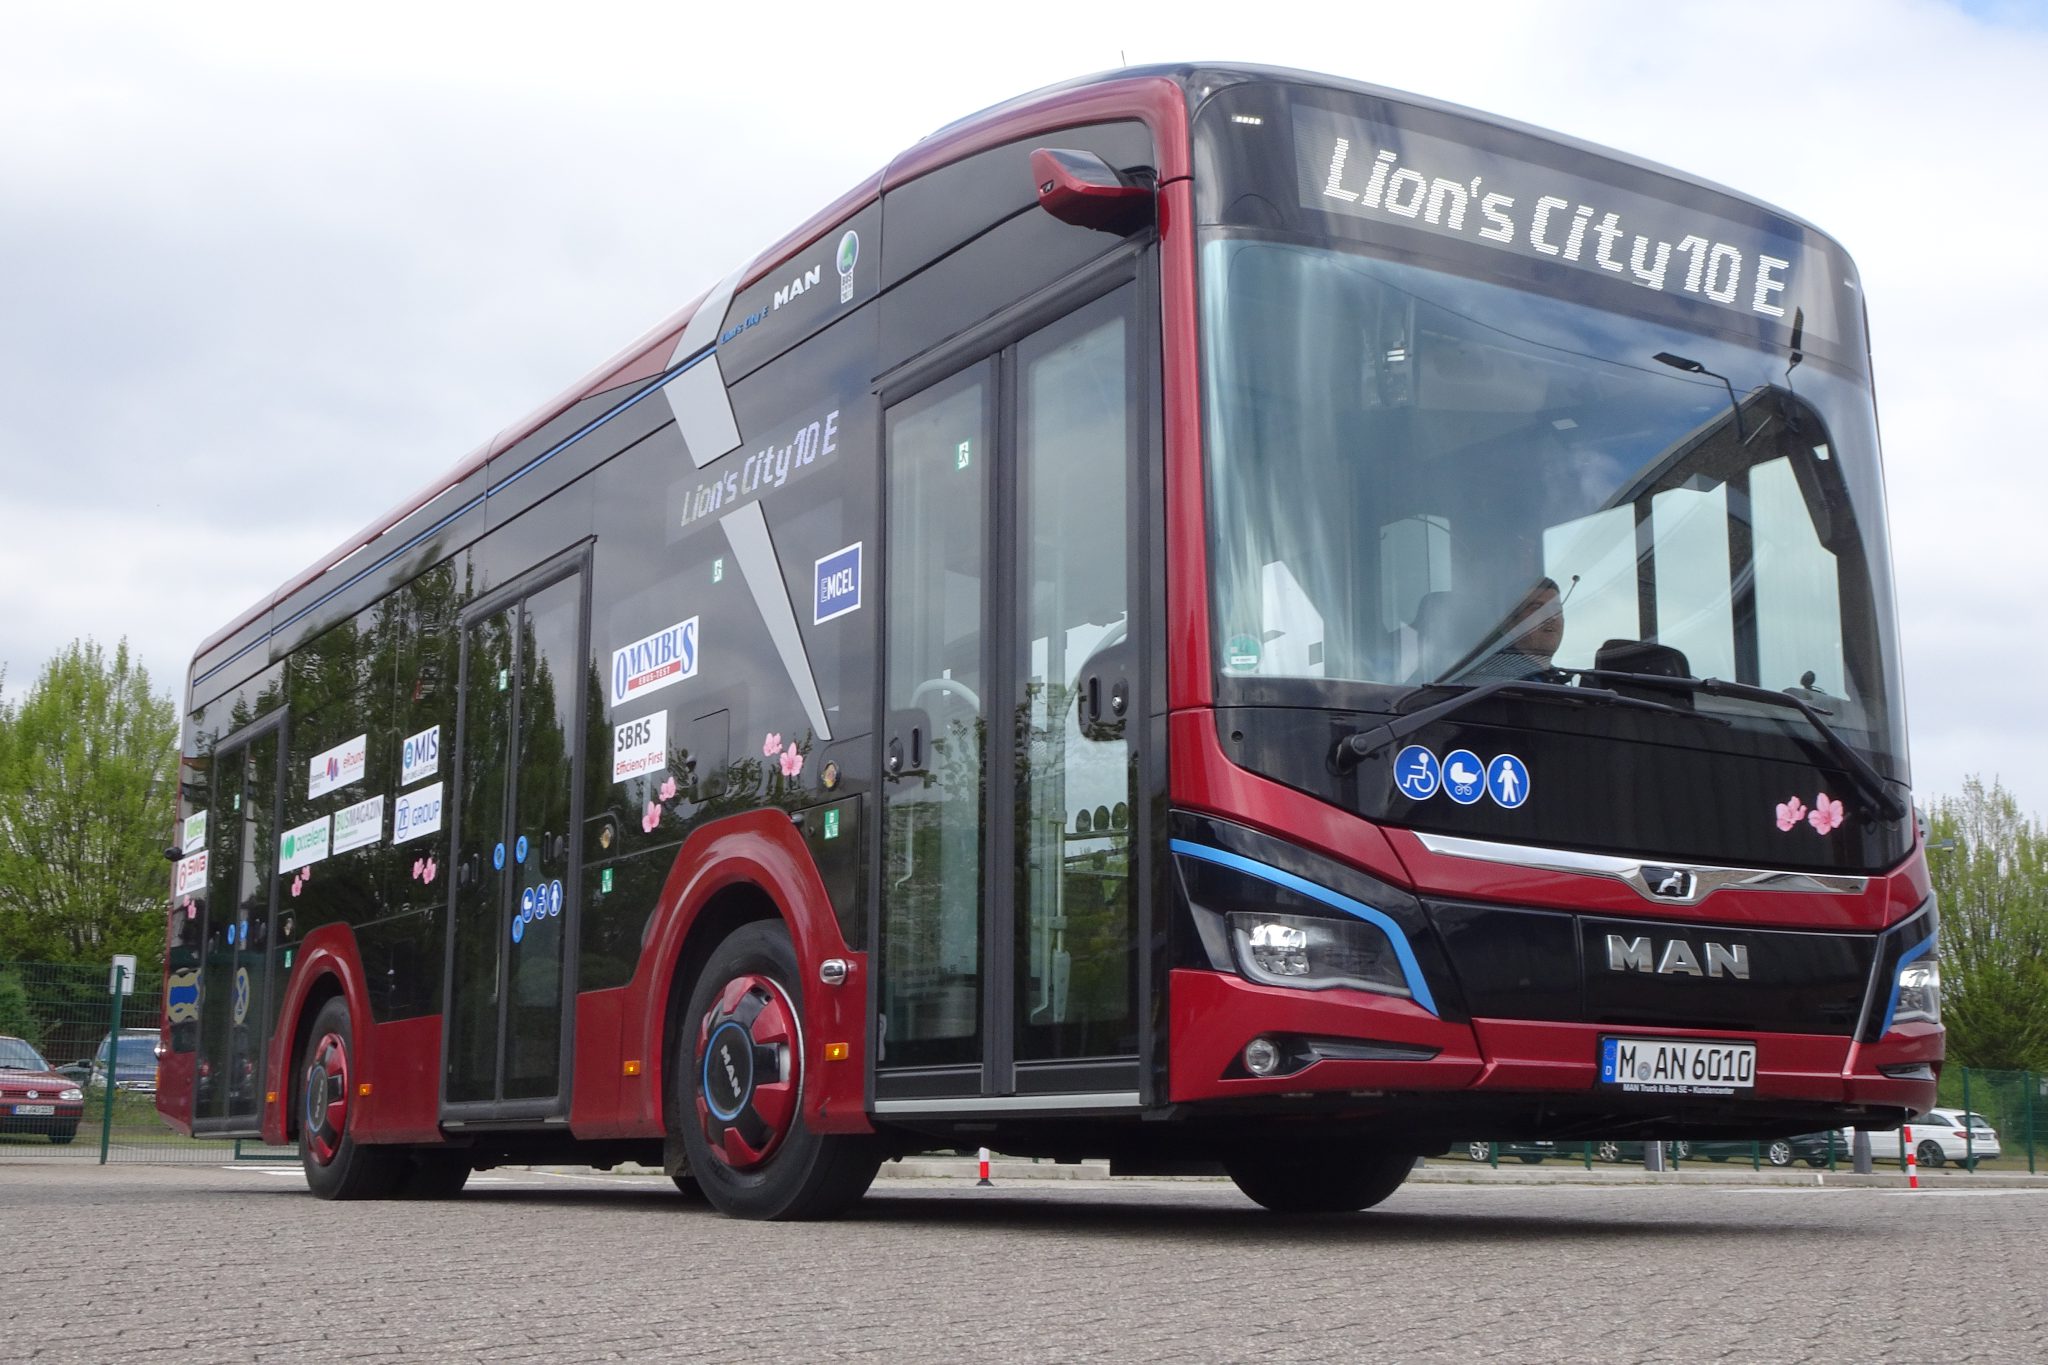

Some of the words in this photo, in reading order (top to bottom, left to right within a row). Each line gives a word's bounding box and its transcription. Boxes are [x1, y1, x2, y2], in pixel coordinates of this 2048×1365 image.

[1323, 137, 1515, 243] Lion's
[1753, 254, 1789, 317] E
[773, 264, 821, 311] MAN
[681, 470, 738, 526] Lion's
[822, 409, 839, 456] E
[615, 622, 694, 700] OMNIBUS
[617, 719, 651, 752] SBRS
[647, 751, 664, 766] First
[412, 800, 440, 826] GROUP
[1605, 934, 1750, 980] MAN
[720, 1044, 742, 1098] MAN
[1605, 1065, 1612, 1076] D
[1619, 1045, 1637, 1078] M
[1623, 1083, 1639, 1092] MAN
[1641, 1084, 1657, 1092] Truck
[1665, 1085, 1677, 1093] Bus
[1678, 1086, 1687, 1094] SE
[1692, 1086, 1735, 1095] Kundencenter
